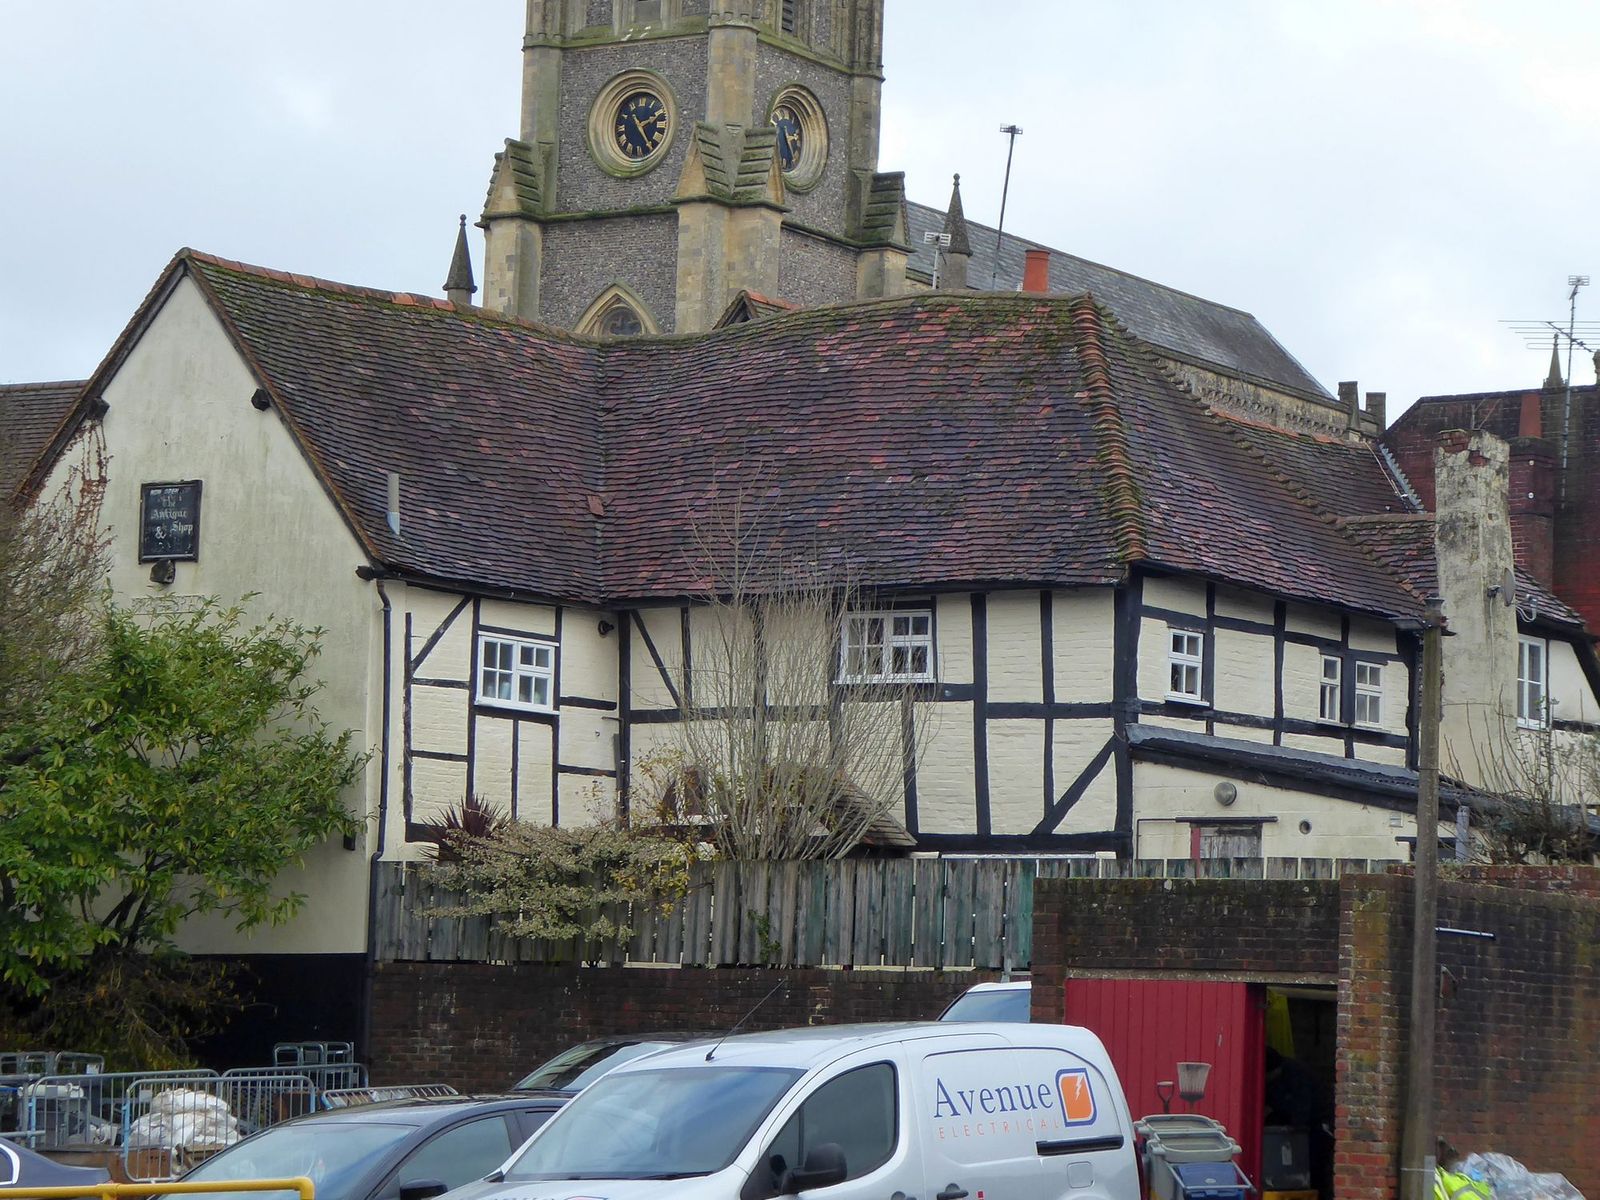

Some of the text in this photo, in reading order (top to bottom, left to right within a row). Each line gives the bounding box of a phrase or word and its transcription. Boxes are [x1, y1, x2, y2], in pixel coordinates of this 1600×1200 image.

[155, 526, 166, 539] &
[170, 520, 194, 535] Shop
[933, 1077, 1055, 1119] Avenue
[938, 1118, 1061, 1140] ELECTRICAL
